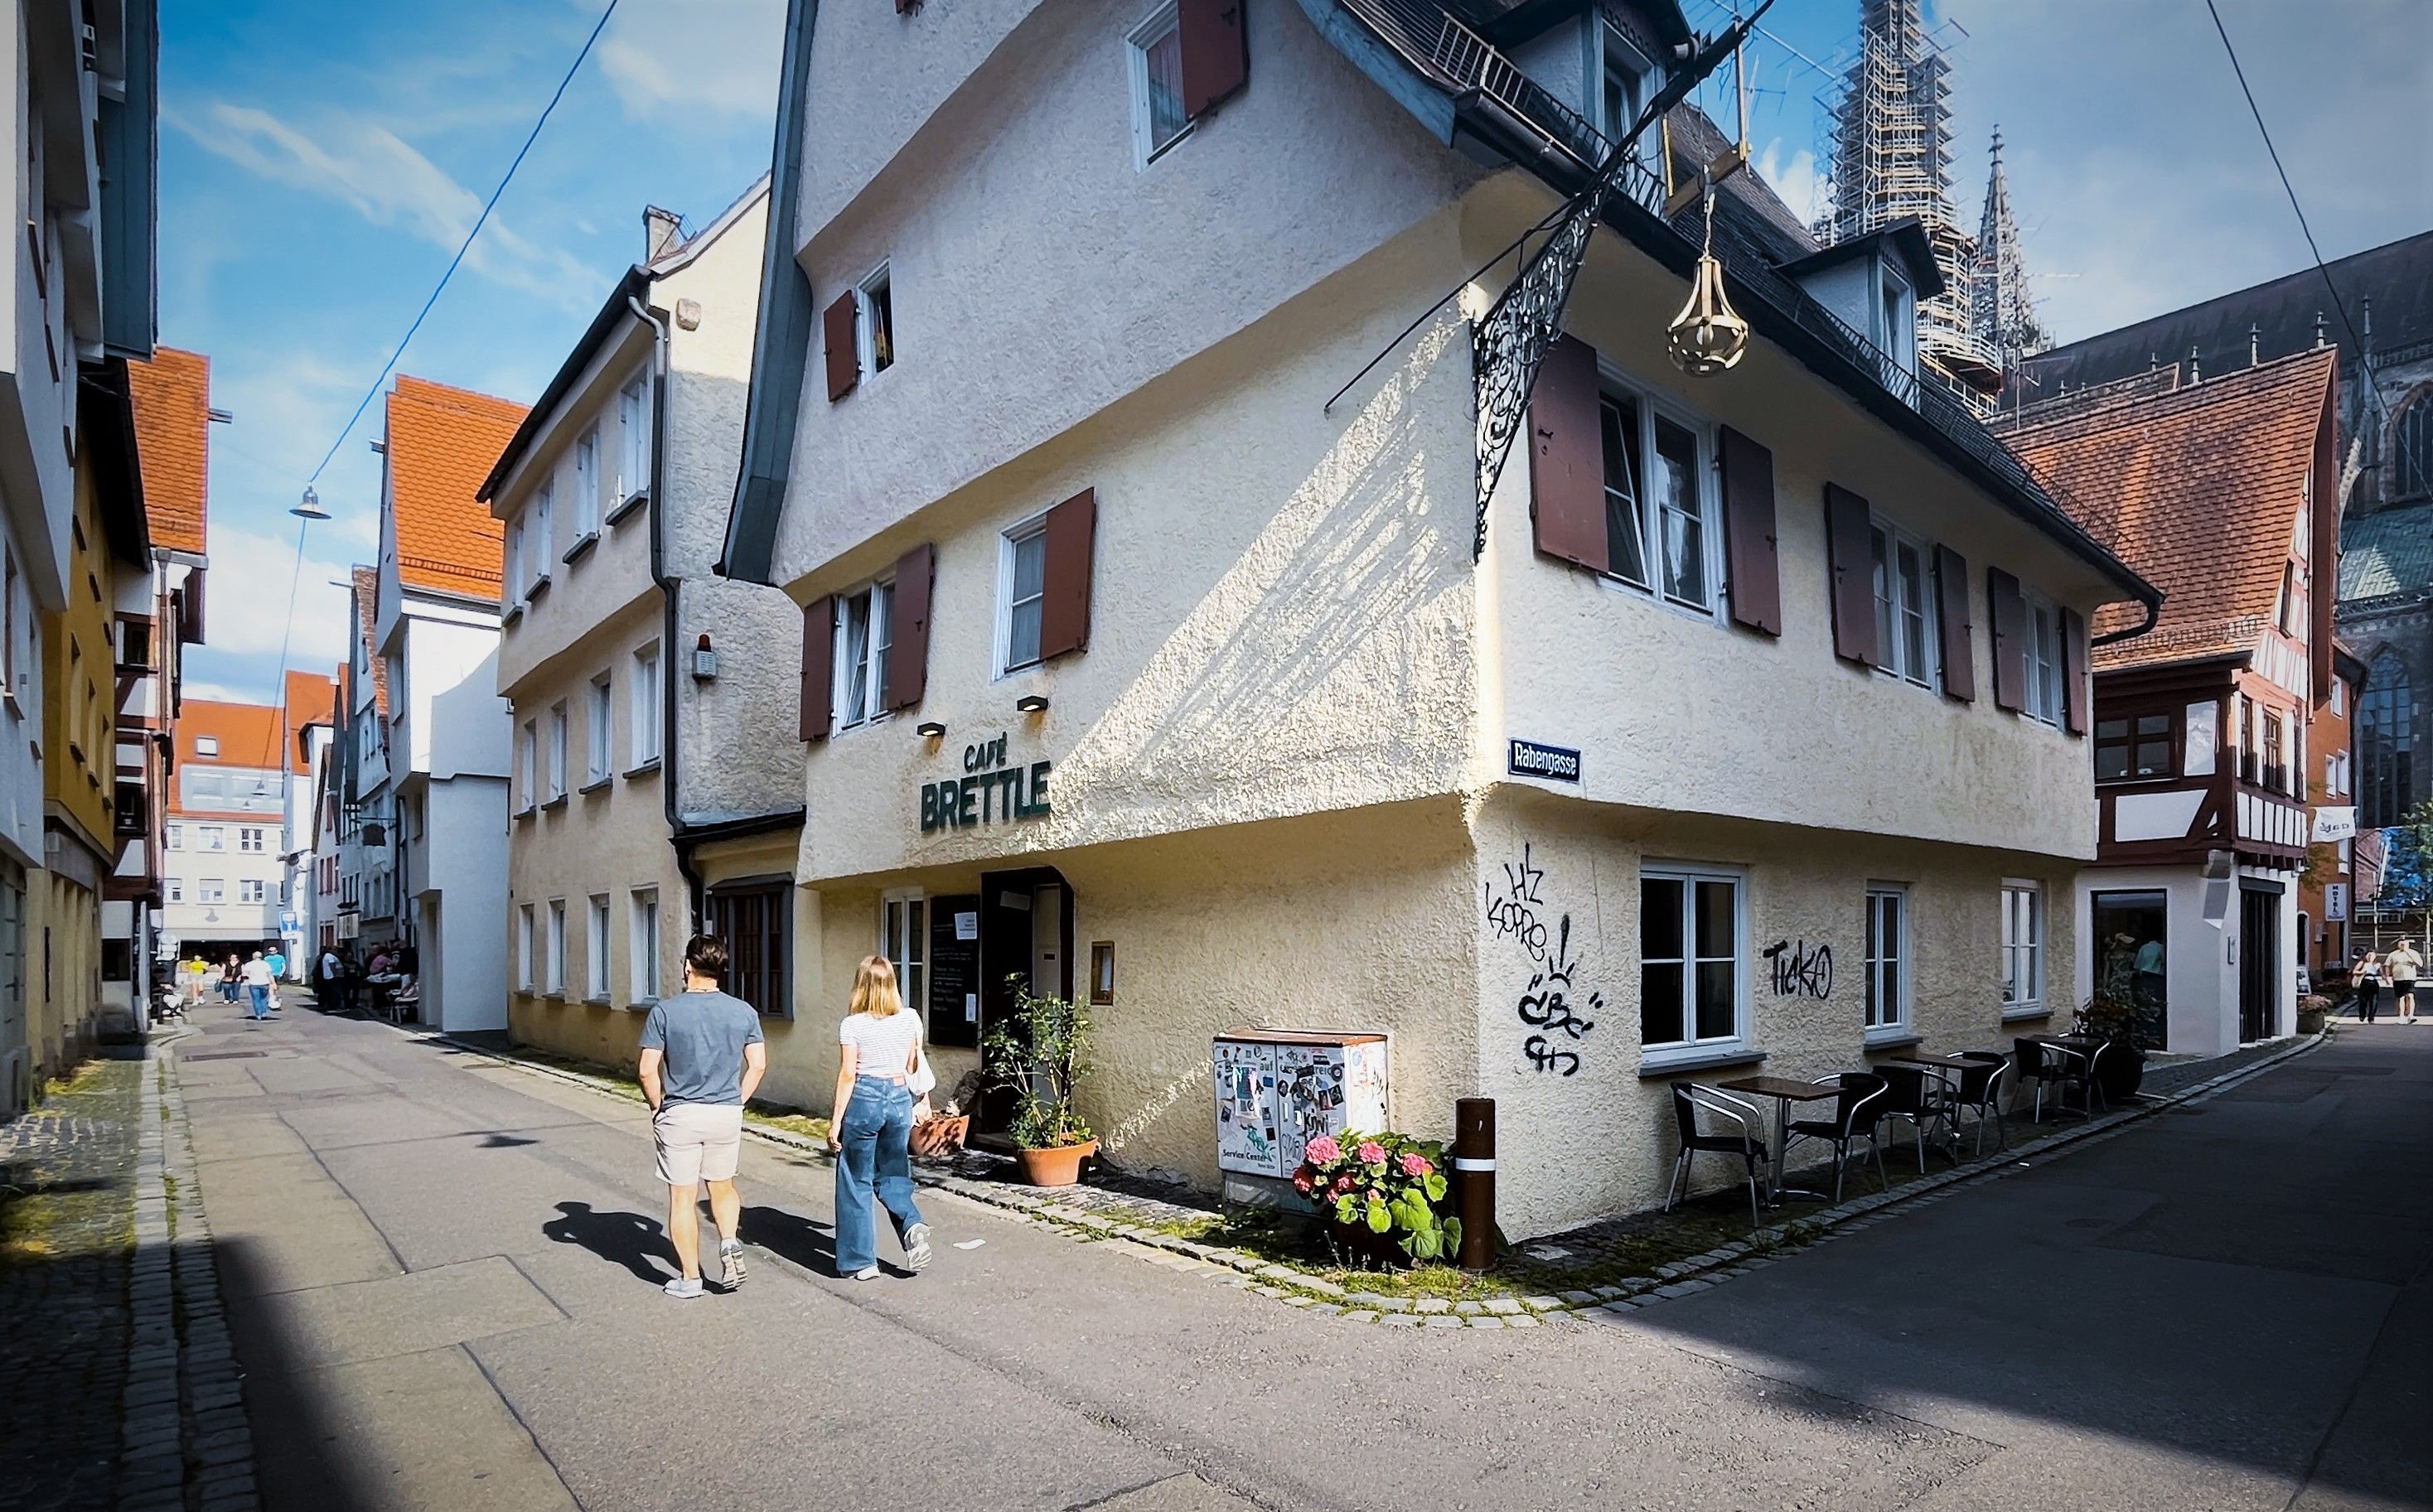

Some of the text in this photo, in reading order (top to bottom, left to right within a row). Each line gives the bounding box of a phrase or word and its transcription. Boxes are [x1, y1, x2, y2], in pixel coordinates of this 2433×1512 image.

[964, 732, 1008, 773] CAFÉ
[1514, 742, 1576, 775] Rabengasse
[921, 761, 1052, 832] BRETTLE
[1260, 1060, 1274, 1071] auf
[1222, 1149, 1266, 1162] Service Center
